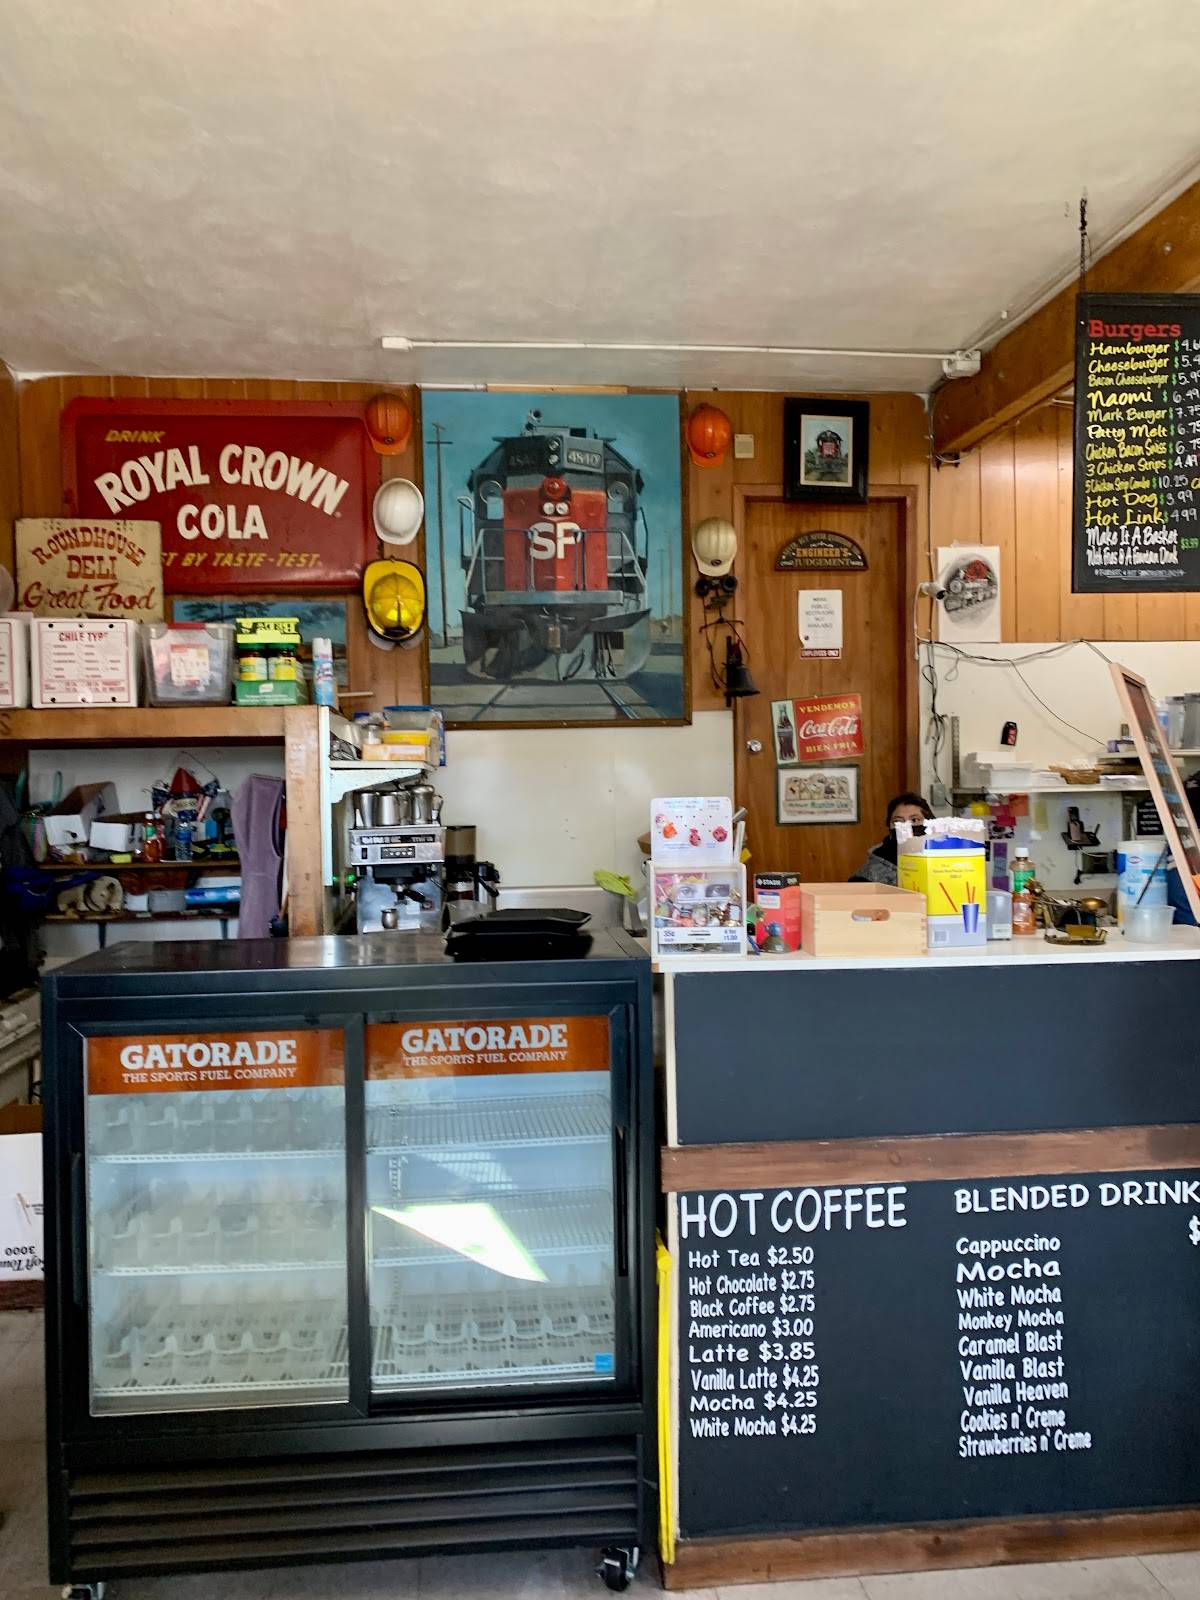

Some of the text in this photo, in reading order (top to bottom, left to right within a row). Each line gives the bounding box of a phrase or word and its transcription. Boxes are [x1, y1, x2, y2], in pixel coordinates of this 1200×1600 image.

[1089, 320, 1181, 341] Burgers
[1090, 342, 1170, 358] Hamburger
[1088, 358, 1169, 373] Cheeseburger
[1088, 374, 1114, 387] Bacon
[1115, 372, 1169, 388] Cheeseburger
[1087, 387, 1153, 409] Naomi
[1087, 409, 1124, 423] Mark
[1126, 407, 1167, 424] Burger
[105, 430, 166, 443] DRINK
[1087, 424, 1126, 442] Patty
[1129, 424, 1167, 438] Melt
[1086, 442, 1117, 460] Chicken
[1118, 442, 1144, 458] Bacon
[1144, 439, 1167, 456] Swiss
[1086, 464, 1095, 477] 3
[1096, 460, 1136, 475] Chicken
[1137, 458, 1167, 474] Strips
[94, 443, 350, 516] ROYAL CROWN
[1090, 478, 1115, 493] Chicken
[1085, 495, 1119, 509] Hot
[1122, 491, 1158, 508] Dog
[177, 504, 269, 540] COLA
[1085, 509, 1119, 527] Hot
[1125, 506, 1163, 526] Link
[528, 522, 581, 560] SP
[1086, 525, 1118, 546] Make
[1120, 525, 1130, 546] It
[1131, 525, 1141, 546] A
[1143, 524, 1178, 546] Basket
[32, 526, 146, 567] ROUNDHOUSE
[796, 548, 848, 557] ENGINEER'S
[67, 555, 117, 579] DELI
[182, 552, 208, 567] BY
[23, 581, 156, 611] Great Food
[800, 701, 856, 713] VENDEMOS
[806, 743, 830, 753] BIEN
[401, 1024, 568, 1053] GATORADE
[120, 1040, 297, 1070] GATORADE
[404, 1050, 568, 1067] THE SPORTS FUEL COMPANY
[122, 1067, 297, 1084] THE SPORTS FUEL COMPANY
[954, 1184, 1090, 1214] BLENDED
[681, 1186, 907, 1238] HOT COFFEE
[5, 1245, 35, 1256] 3000
[689, 1246, 814, 1268] Hot Tea $2.50
[956, 1234, 1061, 1259] Cappuccino
[956, 1258, 1061, 1283] Mocha
[689, 1269, 815, 1295] Hot Chocolate $2.75
[690, 1293, 815, 1317] Black Coffee $2.75
[957, 1284, 1062, 1309] White Mocha
[689, 1317, 814, 1339] Americano $3.00
[958, 1308, 1064, 1332] Monkey Mocha
[689, 1341, 815, 1363] Latte $3.85
[958, 1330, 1063, 1357] Caramel Blast
[691, 1363, 819, 1391] Vanilla Latte $4.25
[960, 1356, 1065, 1381] Vanilla Blast
[690, 1390, 818, 1412] Mocha $4.25
[964, 1381, 1069, 1407] Vanilla Heaven
[690, 1412, 816, 1438] White Mocha $4.25
[960, 1408, 1008, 1433] Cookies
[1026, 1406, 1066, 1429] Creme
[959, 1433, 1037, 1458] Strawberries
[1054, 1429, 1092, 1451] Creme
